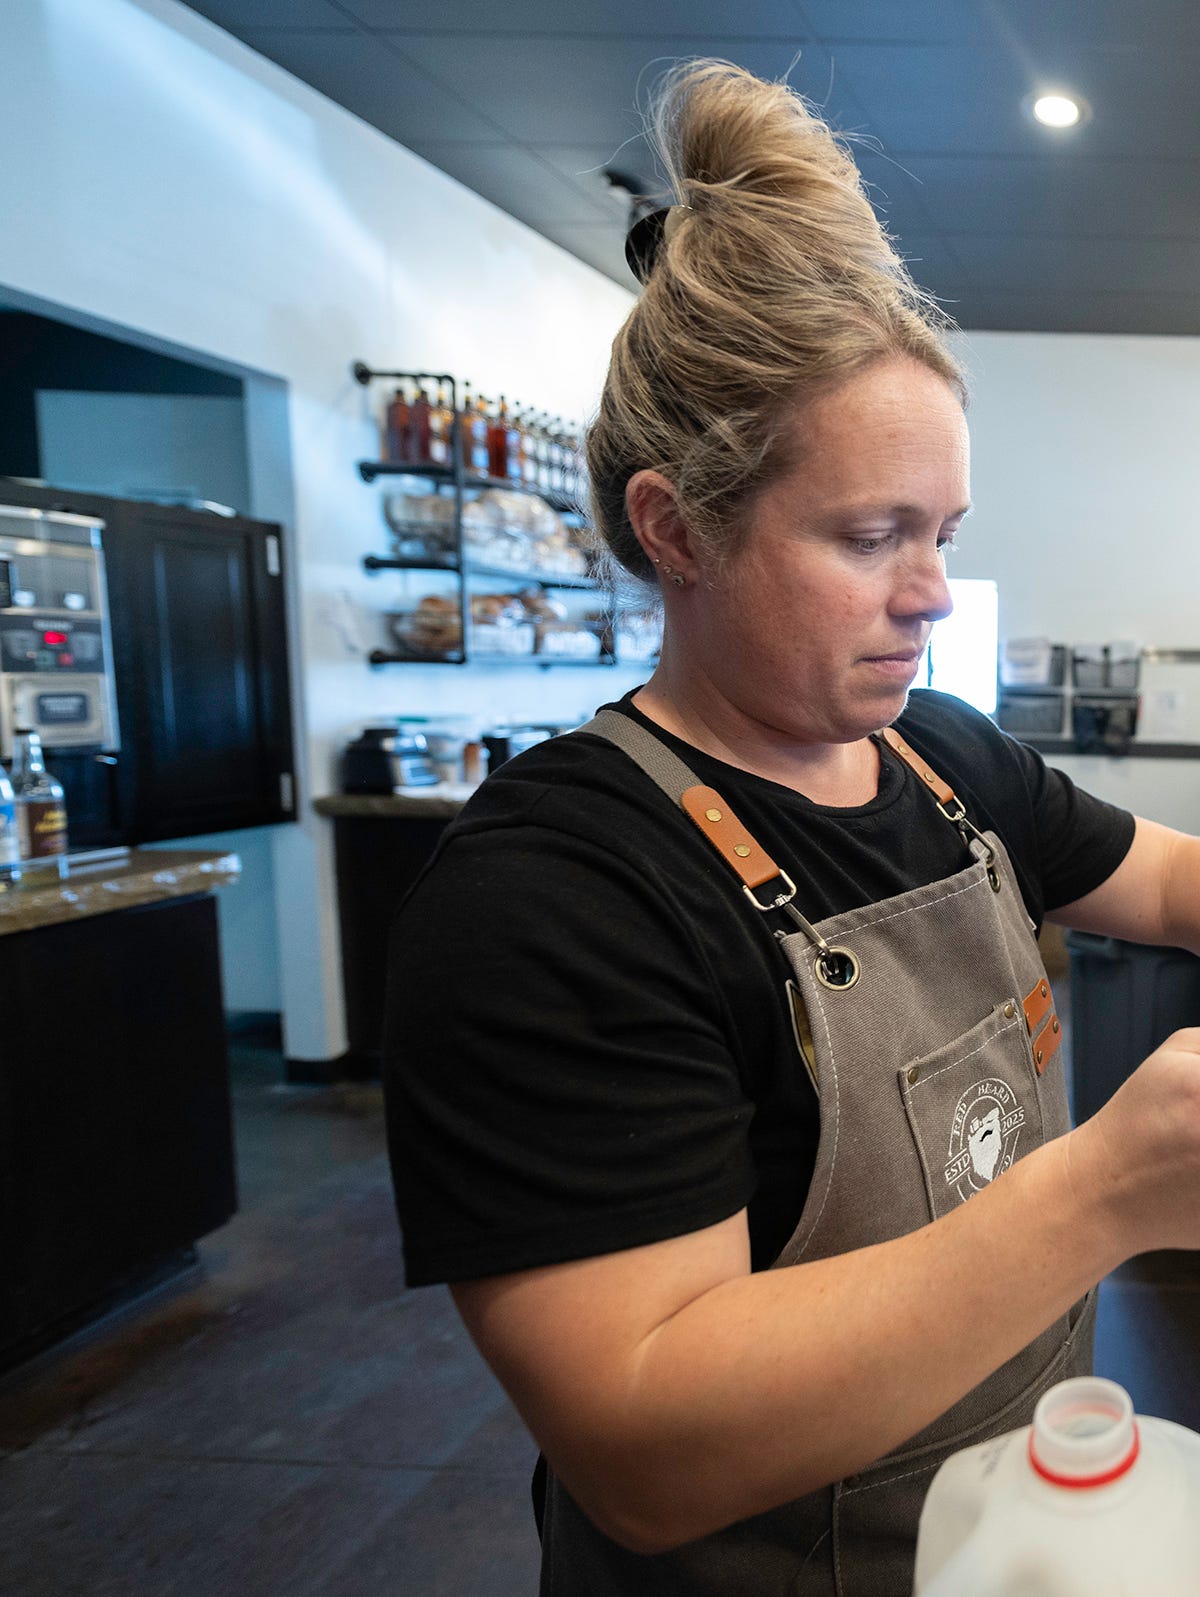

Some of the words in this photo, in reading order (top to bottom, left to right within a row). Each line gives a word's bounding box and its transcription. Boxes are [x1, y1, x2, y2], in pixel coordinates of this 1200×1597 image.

[953, 1102, 967, 1137] RED
[1002, 1109, 1025, 1133] 2025
[944, 1152, 970, 1182] ESTD
